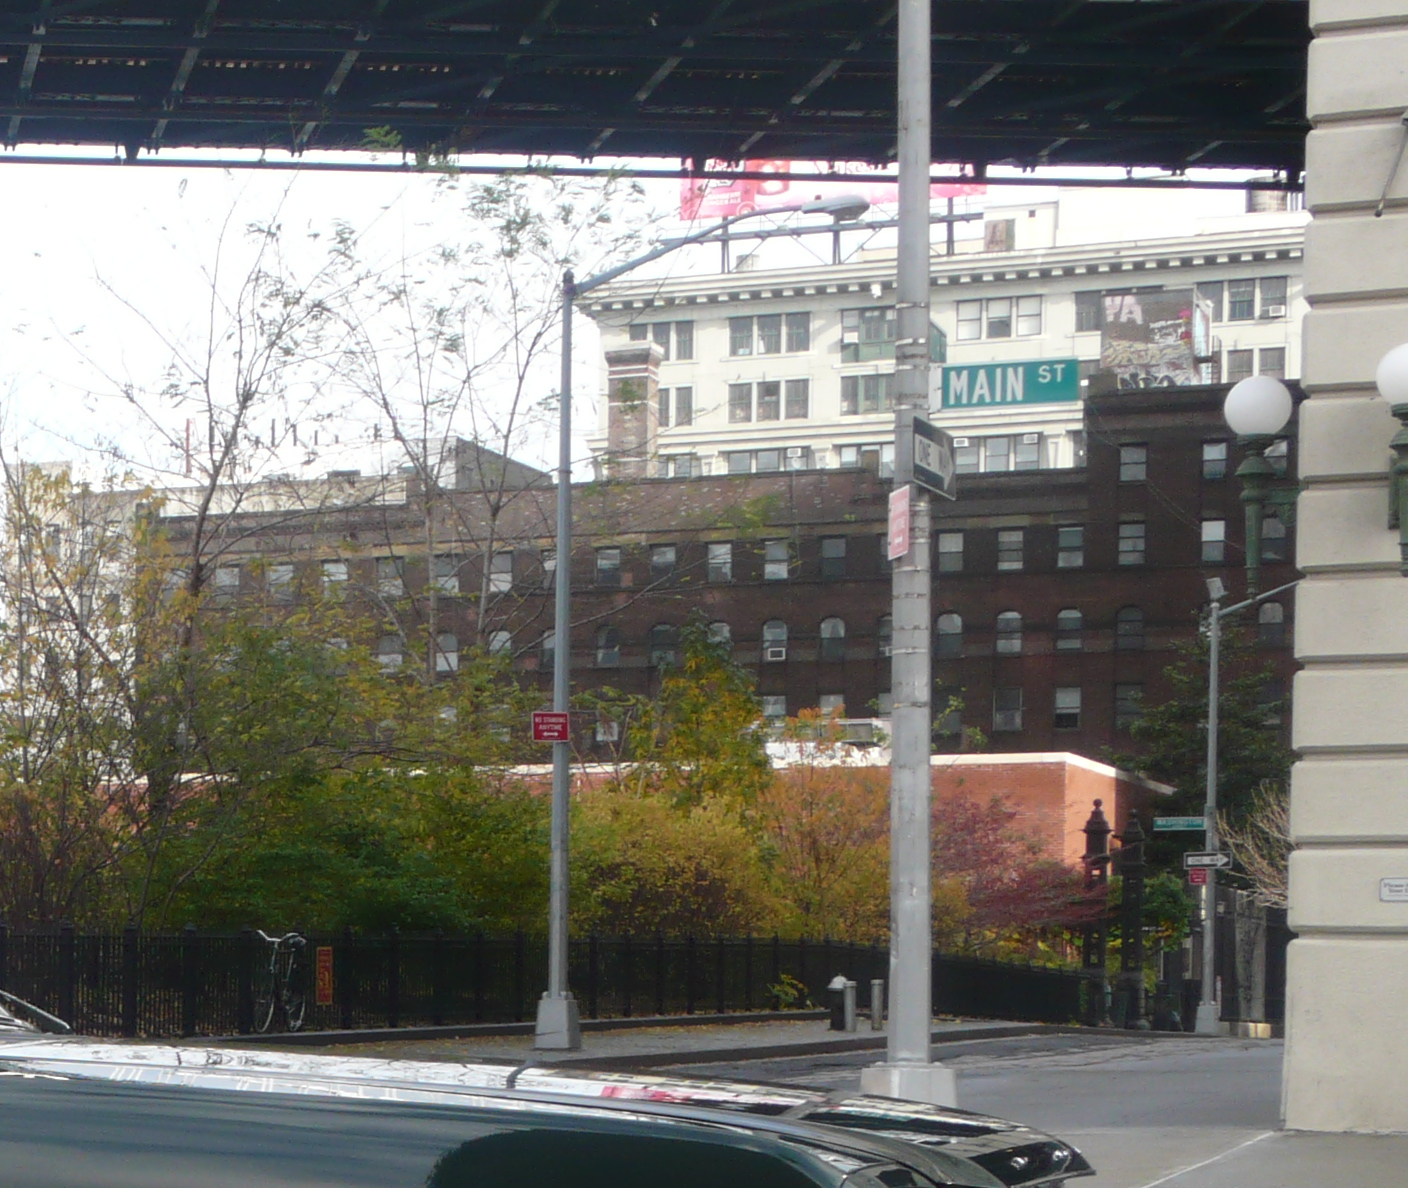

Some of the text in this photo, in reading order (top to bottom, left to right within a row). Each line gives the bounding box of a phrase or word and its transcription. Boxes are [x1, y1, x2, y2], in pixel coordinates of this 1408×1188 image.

[949, 363, 1066, 405] MAIN ST
[919, 439, 932, 467] ONE
